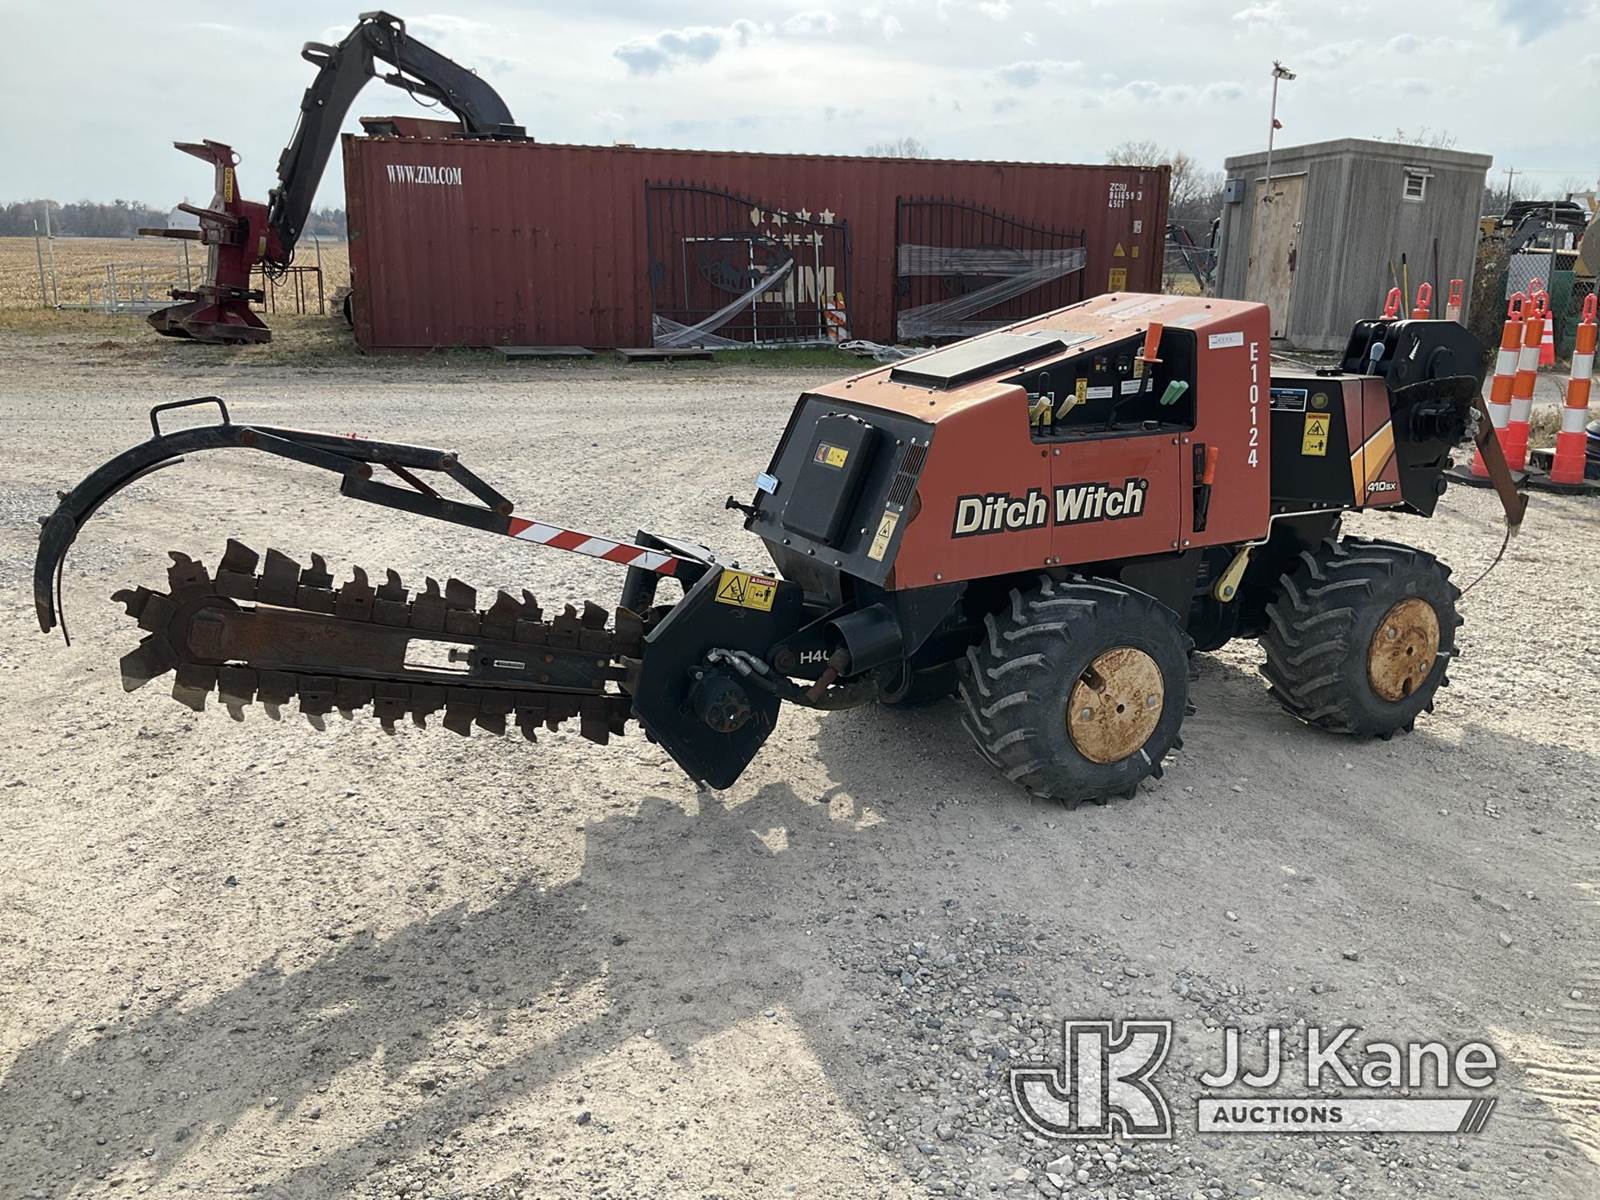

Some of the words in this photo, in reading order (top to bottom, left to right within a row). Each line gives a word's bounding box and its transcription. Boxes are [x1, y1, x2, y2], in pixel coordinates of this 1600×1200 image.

[386, 164, 462, 185] WWW.ZIM.COM
[1247, 342, 1259, 468] E10124
[955, 492, 1047, 534] Ditch
